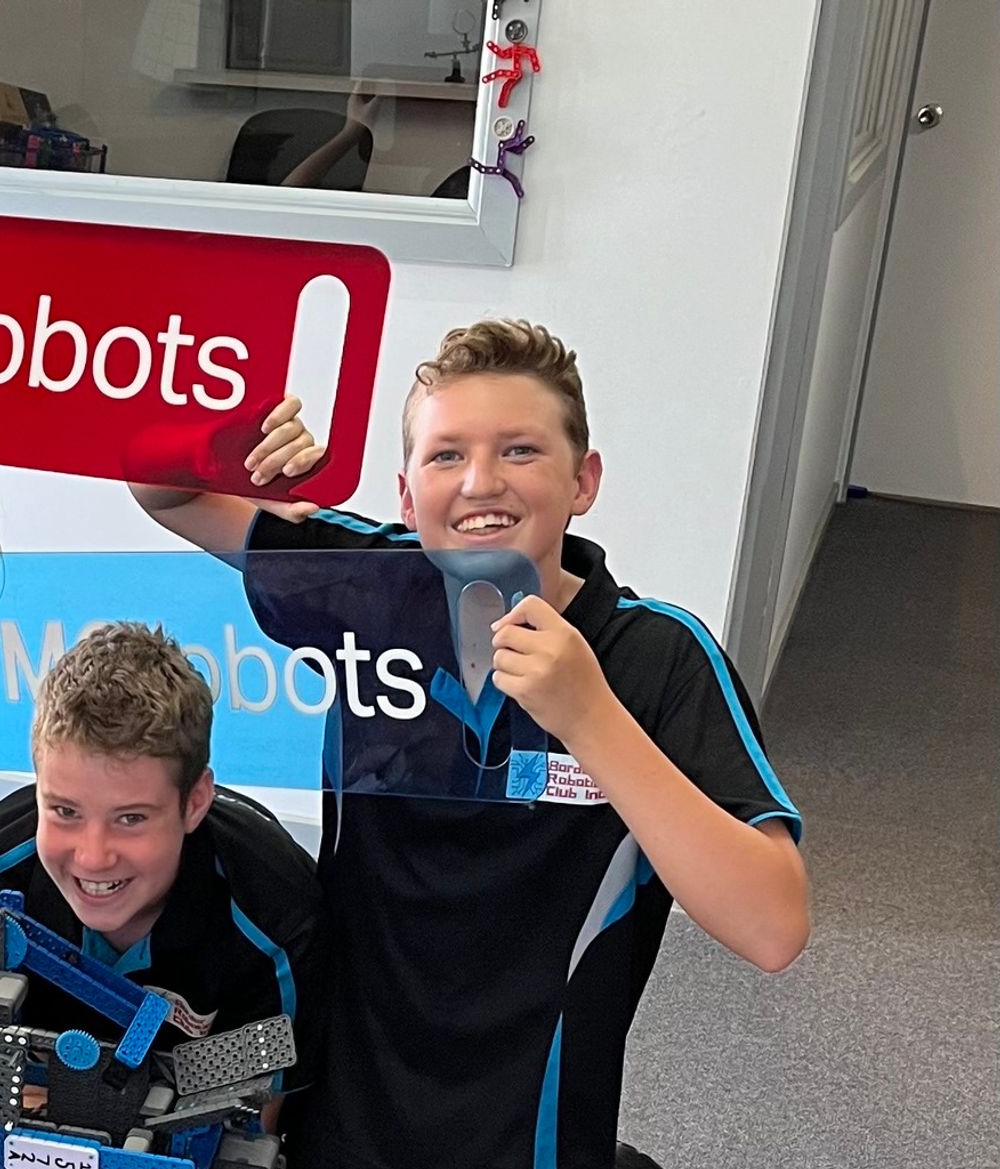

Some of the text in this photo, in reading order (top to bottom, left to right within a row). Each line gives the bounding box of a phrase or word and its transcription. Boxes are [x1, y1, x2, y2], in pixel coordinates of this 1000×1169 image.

[549, 760, 584, 774] Bord
[548, 773, 597, 787] Robot
[546, 786, 577, 798] Club
